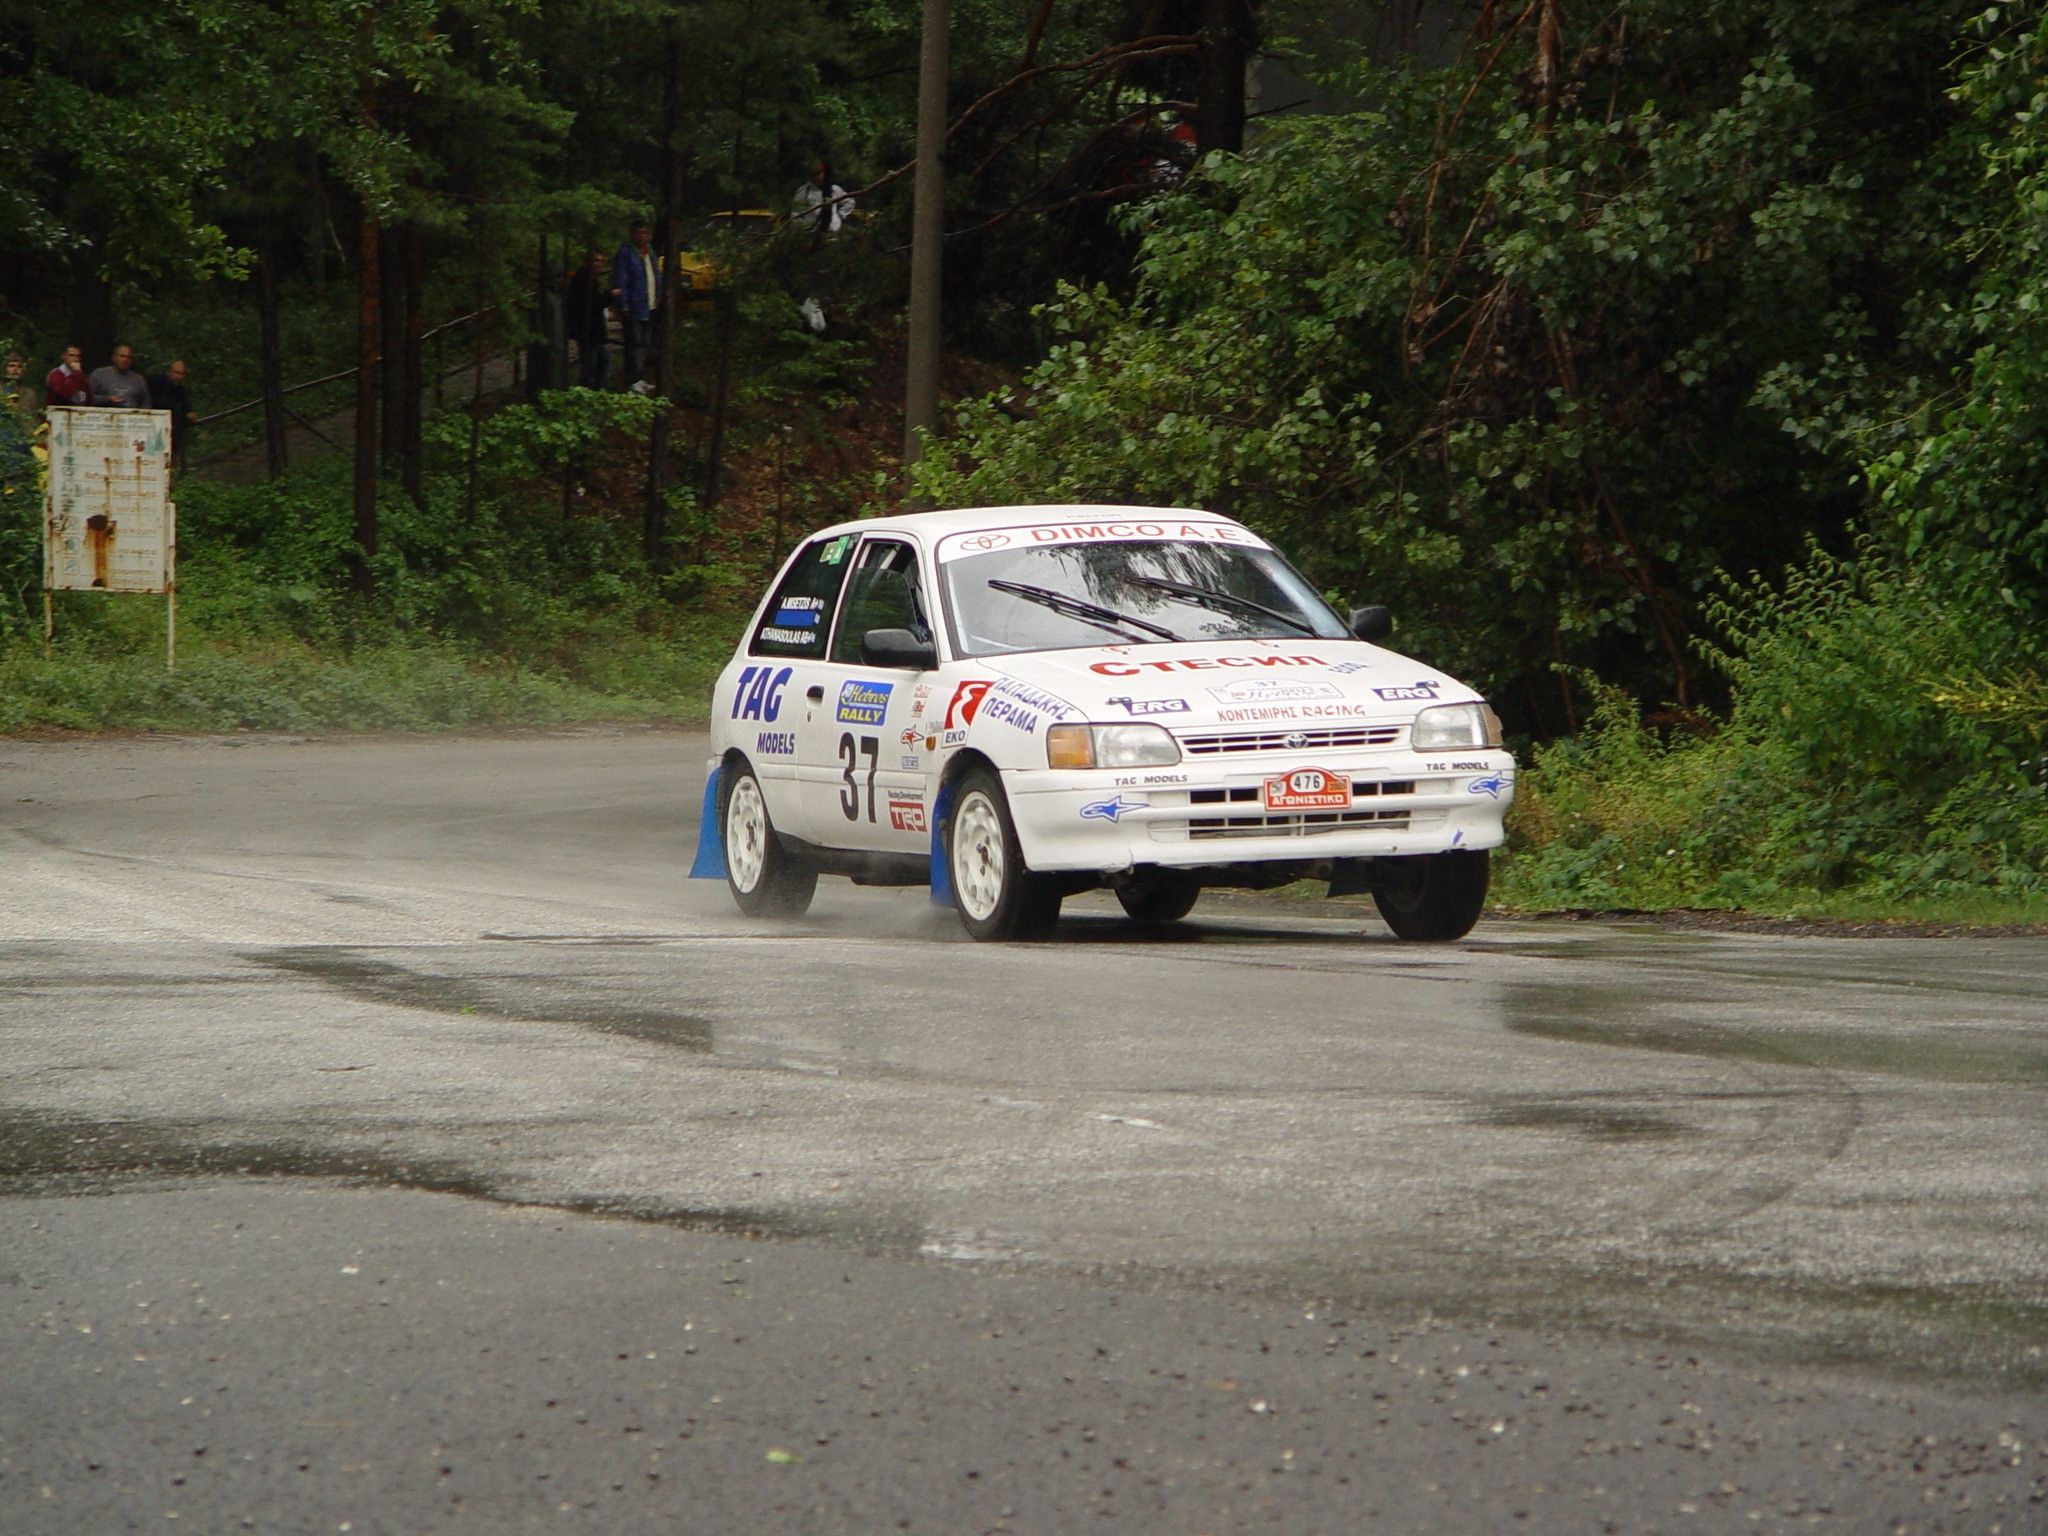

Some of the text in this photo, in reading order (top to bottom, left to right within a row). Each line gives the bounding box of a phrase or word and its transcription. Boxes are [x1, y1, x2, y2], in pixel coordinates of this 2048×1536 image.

[1031, 524, 1252, 543] DIMCO A.E.
[731, 666, 794, 723] TAG
[993, 677, 1075, 721] ΠΑΠΑΔΑΚΗΣ
[1382, 687, 1432, 699] ERG
[839, 708, 883, 722] RALLY
[1131, 700, 1184, 714] ERG
[1217, 705, 1366, 722] ΚΟΝΤΕΜΙΡΗΣ RACING
[981, 697, 1038, 735] ΠΕΡΑΜΑ
[756, 732, 795, 755] MODELS
[945, 730, 966, 743] EKO
[1452, 761, 1489, 770] MODELS
[839, 732, 879, 824] 37
[1143, 774, 1188, 784] MODELS
[1293, 774, 1321, 790] 476
